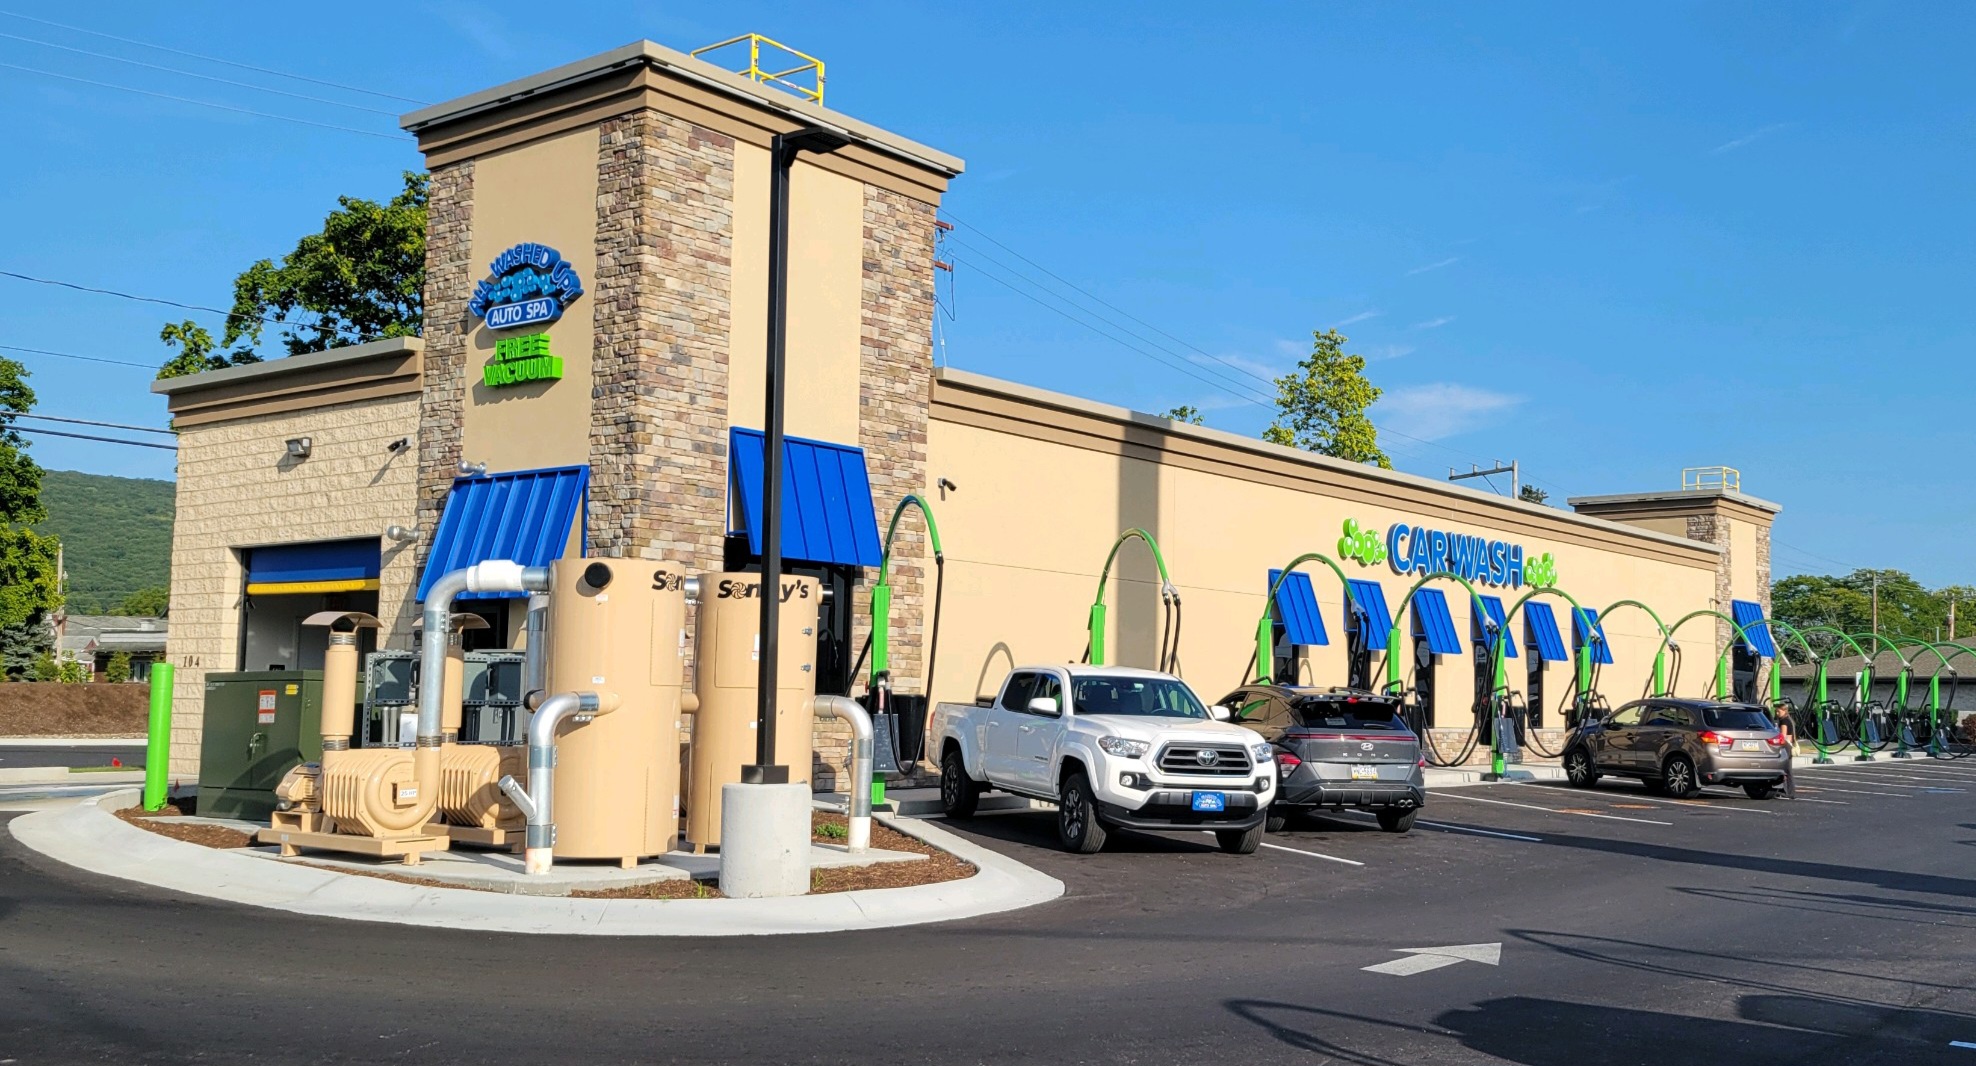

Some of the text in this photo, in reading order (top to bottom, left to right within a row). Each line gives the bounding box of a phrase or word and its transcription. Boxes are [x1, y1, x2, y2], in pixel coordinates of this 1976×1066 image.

[468, 280, 492, 317] ALL
[489, 243, 556, 278] WASHED
[491, 301, 548, 325] AUTO SPA
[495, 333, 547, 361] FREE
[483, 357, 558, 386] VACUUM
[717, 579, 809, 603] Sony's
[183, 655, 200, 668] 104
